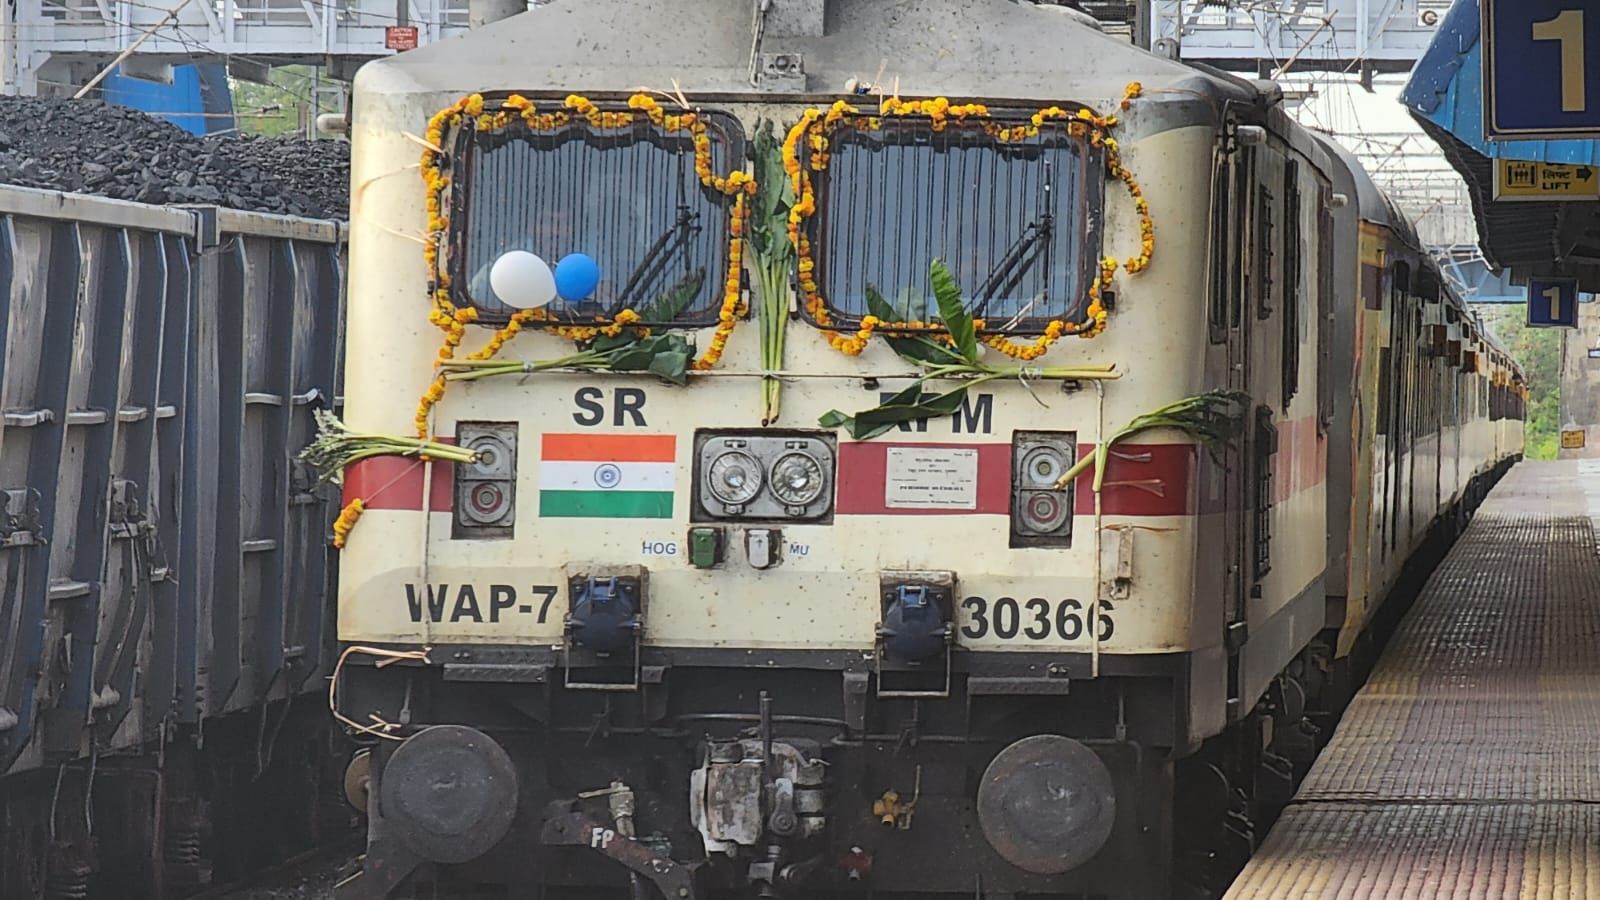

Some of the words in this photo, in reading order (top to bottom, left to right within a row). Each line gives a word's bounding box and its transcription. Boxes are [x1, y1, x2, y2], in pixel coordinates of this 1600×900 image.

[1532, 10, 1585, 112] 1
[1542, 181, 1571, 191] LIFT
[1542, 286, 1560, 321] 1
[572, 386, 648, 427] SR
[642, 542, 677, 555] HOG
[789, 543, 809, 556] MU
[405, 583, 558, 624] WAP-7
[961, 596, 1114, 641] 30366
[591, 827, 615, 849] FP
